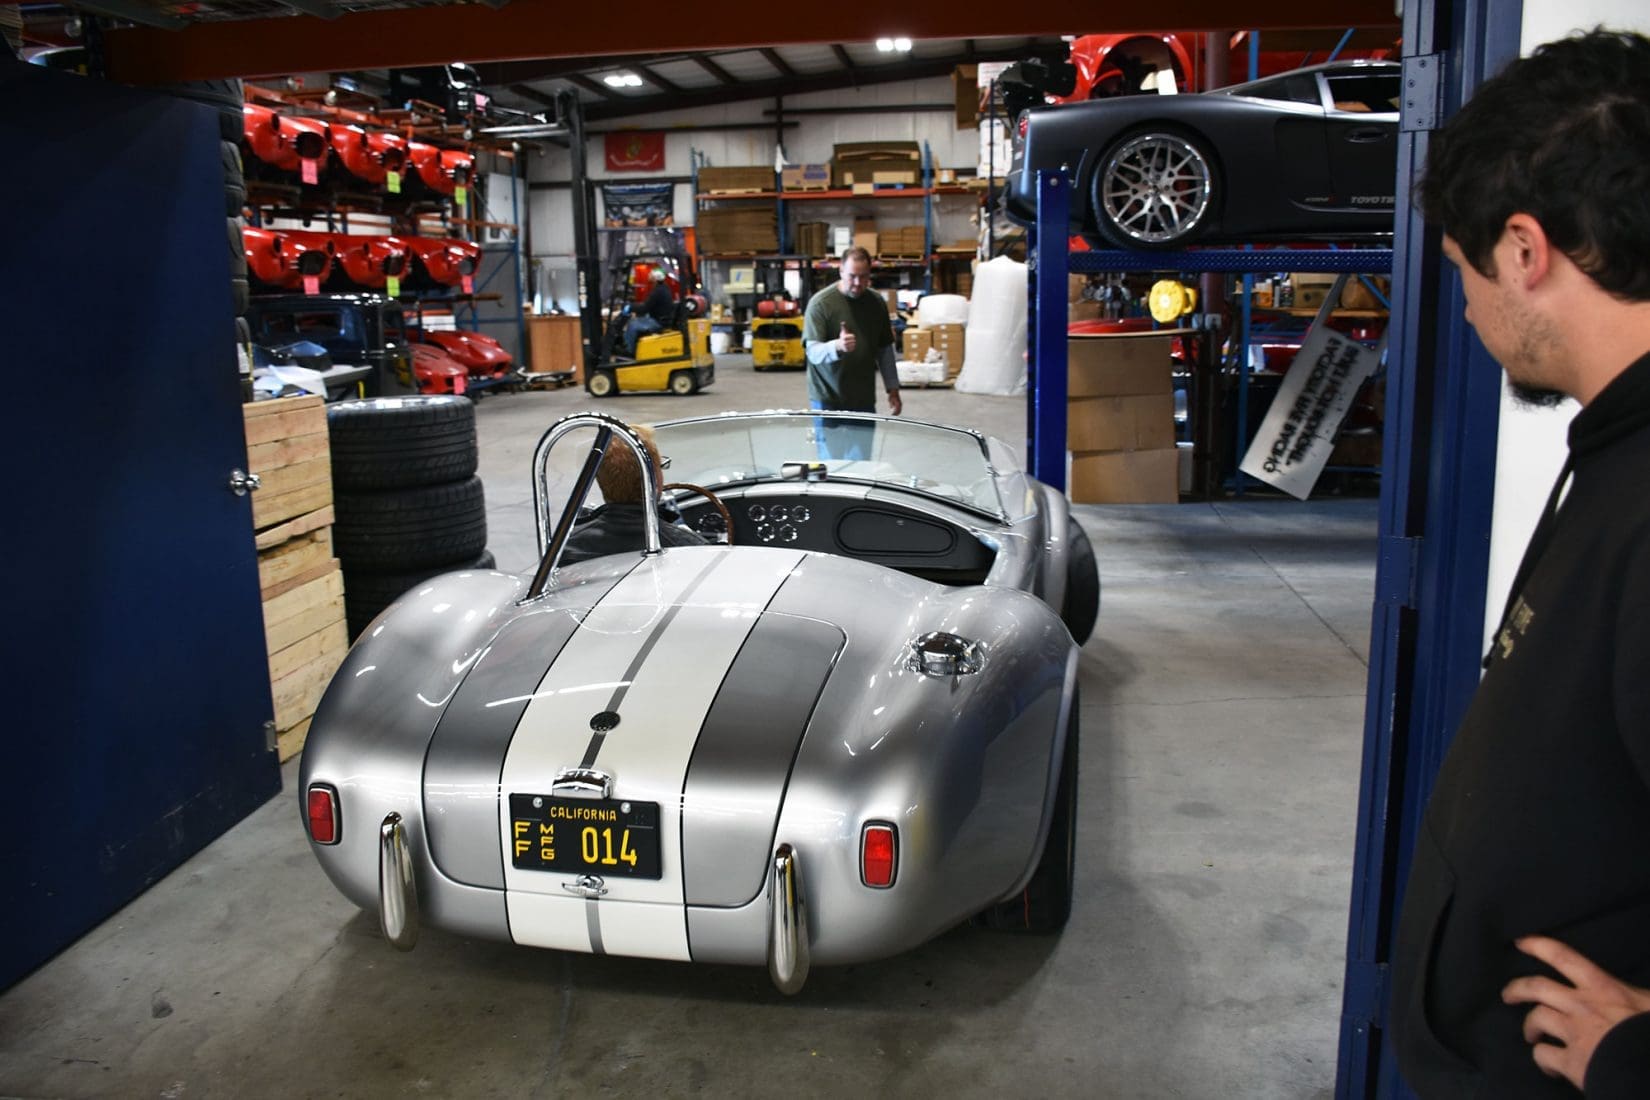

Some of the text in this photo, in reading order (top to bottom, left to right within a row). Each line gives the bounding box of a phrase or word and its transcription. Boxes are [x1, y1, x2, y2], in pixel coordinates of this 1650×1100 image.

[1351, 195, 1379, 204] TOYO
[550, 806, 617, 821] CALIFORNIA
[581, 826, 638, 866] 014
